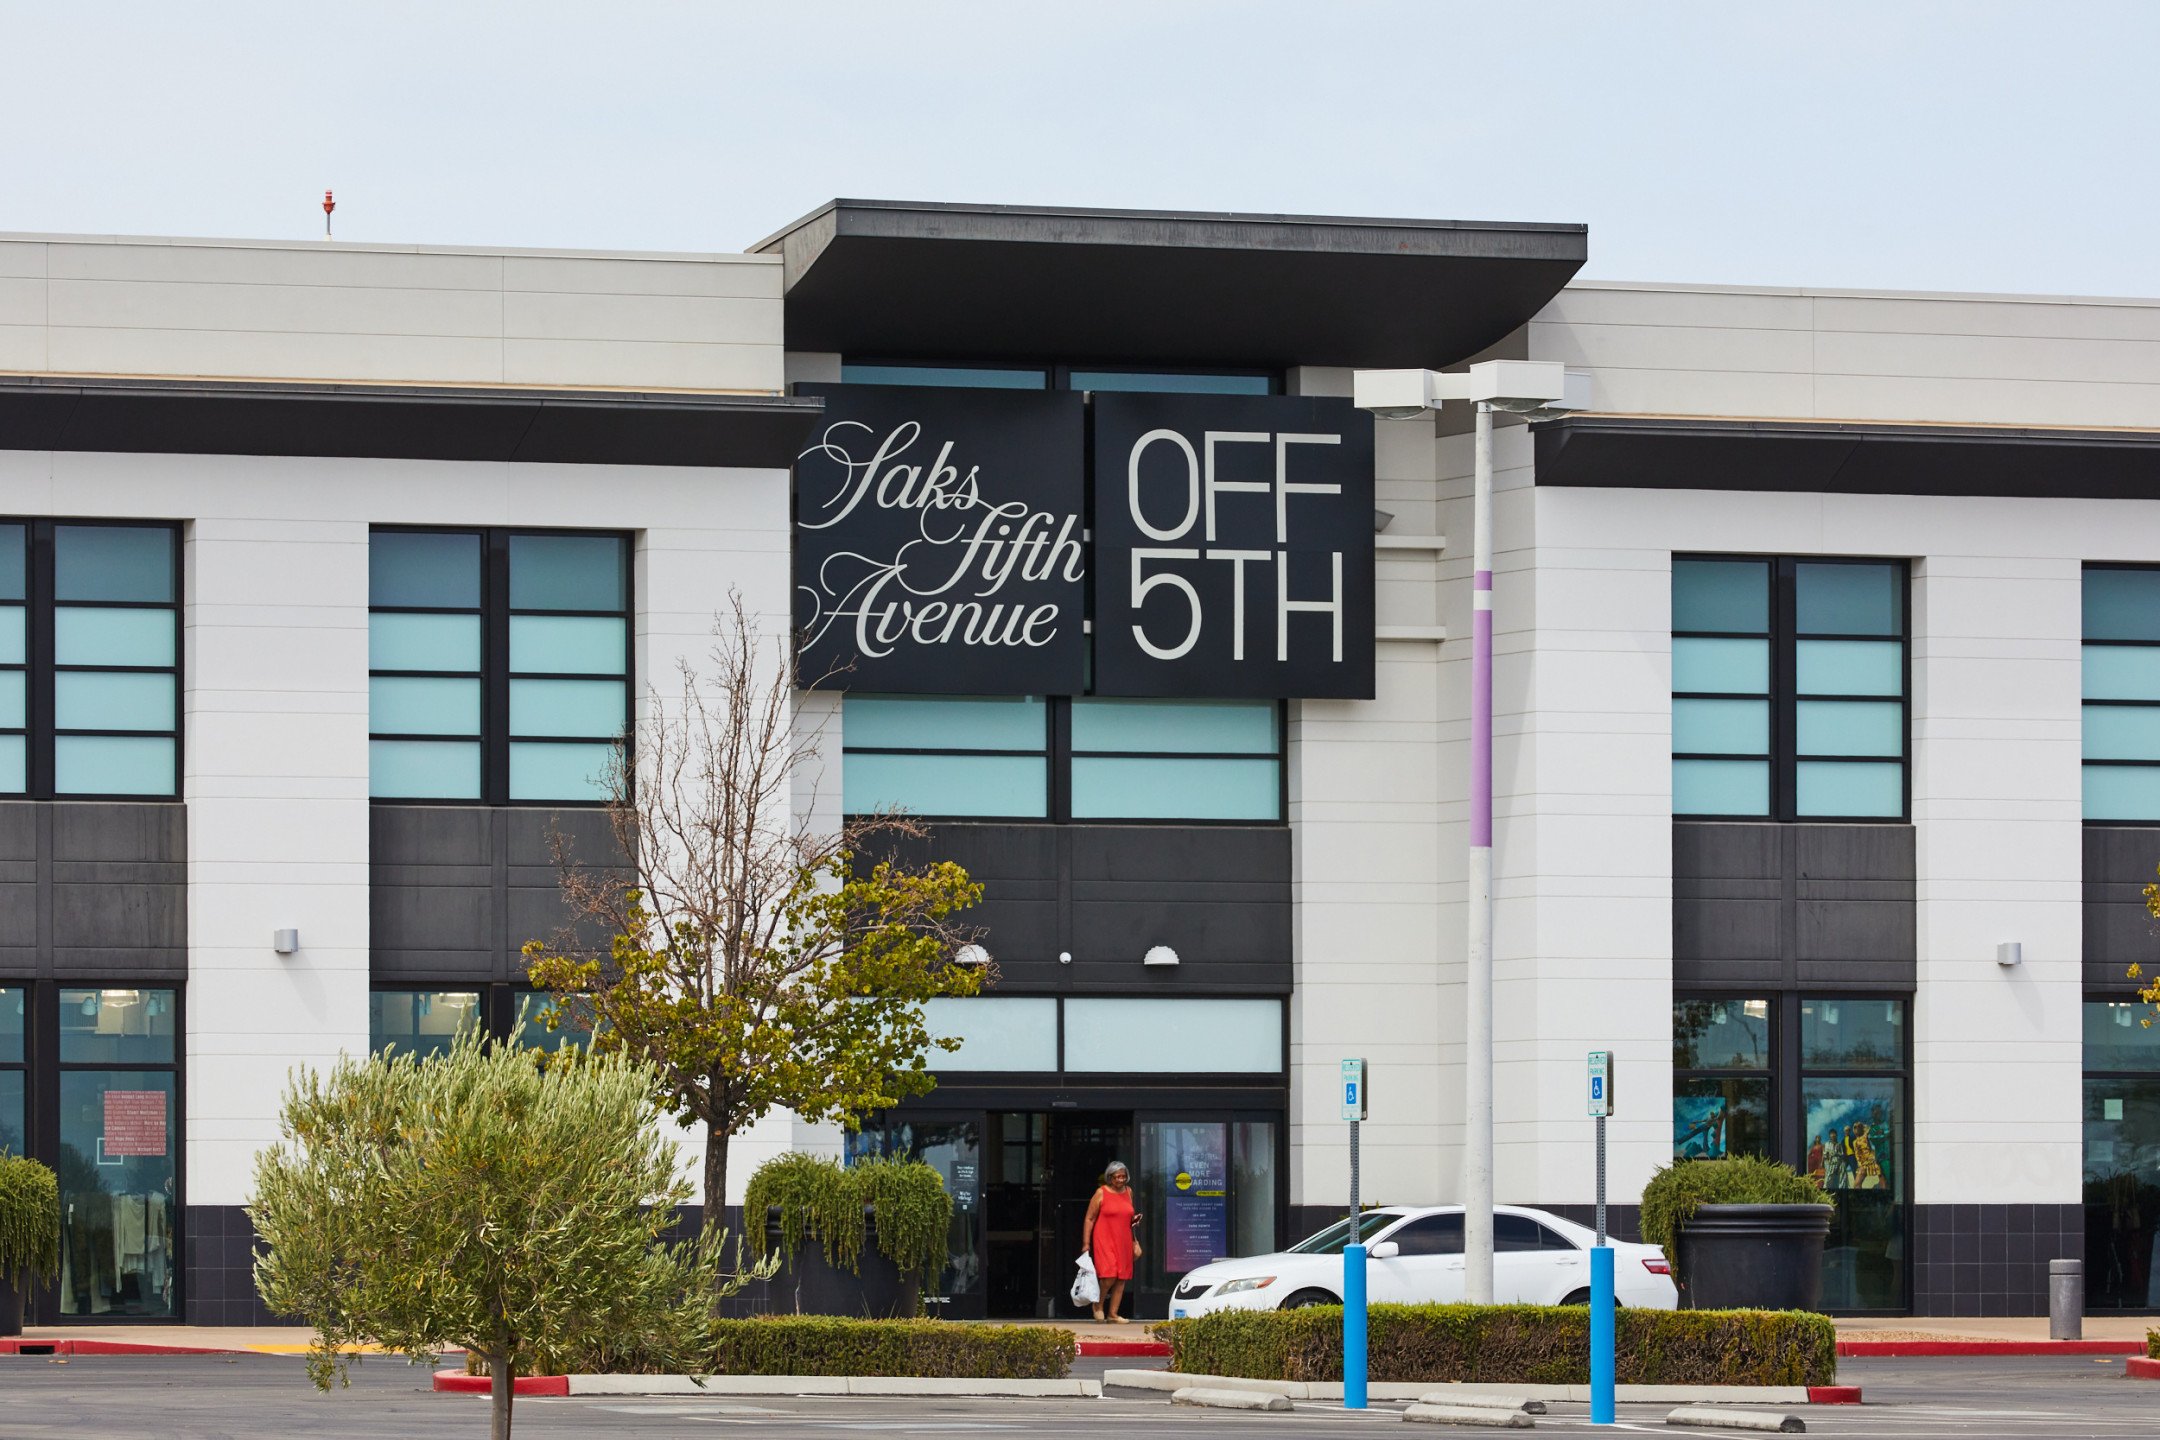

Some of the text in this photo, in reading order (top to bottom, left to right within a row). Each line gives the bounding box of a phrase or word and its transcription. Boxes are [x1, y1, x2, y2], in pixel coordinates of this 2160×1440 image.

[797, 420, 980, 530] Saks
[1128, 428, 1342, 543] OFF
[797, 550, 1060, 659] Avenue
[1130, 547, 1343, 663] 5TH
[1188, 1170, 1211, 1178] MORE
[1189, 1161, 1210, 1169] EVEN
